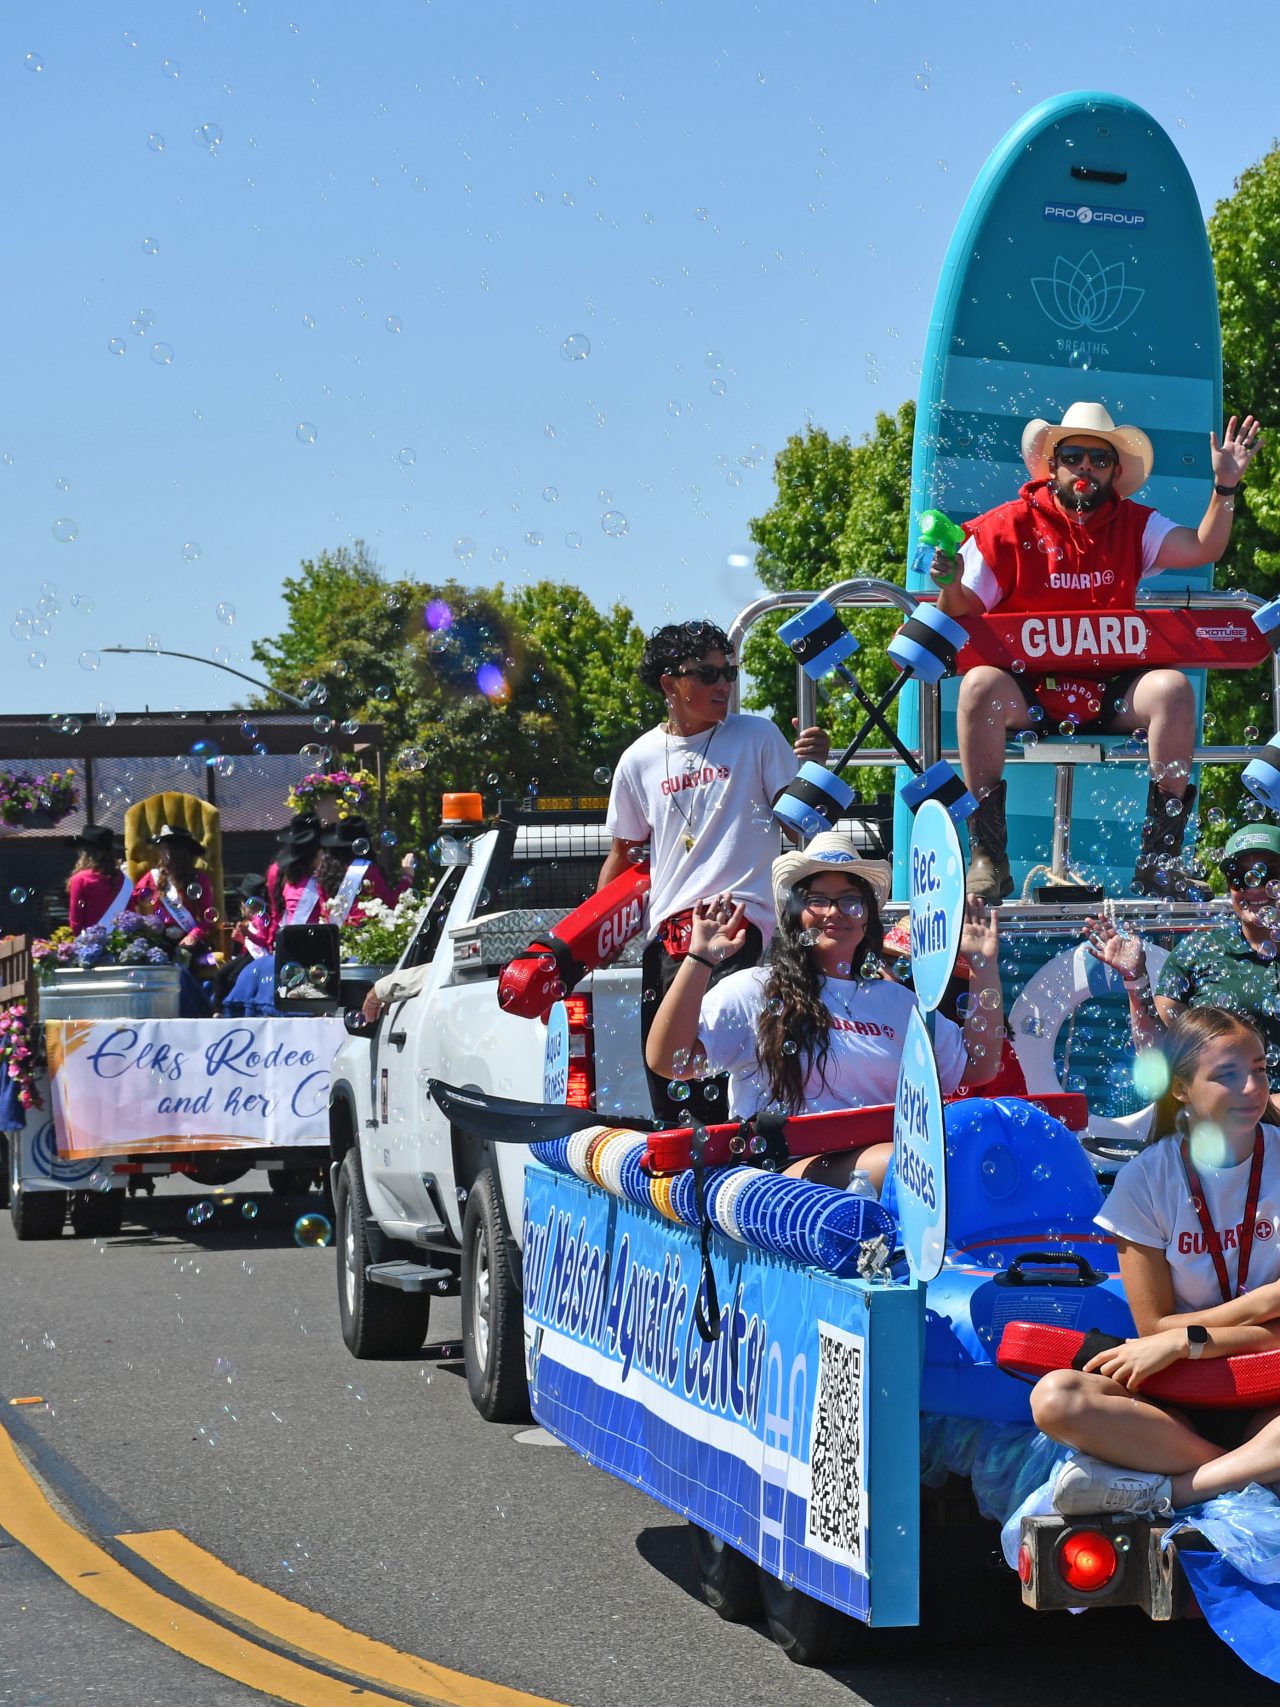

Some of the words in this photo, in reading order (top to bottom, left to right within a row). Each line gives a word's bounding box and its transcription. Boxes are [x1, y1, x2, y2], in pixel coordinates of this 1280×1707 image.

[1044, 206, 1076, 218] PRO
[1093, 212, 1145, 225] GROUP
[1057, 338, 1108, 355] BREATHE
[1050, 571, 1101, 589] GUARD
[1021, 616, 1147, 658] GUARD
[1197, 628, 1246, 637] EXOTUBE
[1055, 682, 1093, 700] GUARD
[661, 767, 715, 796] GUARD
[913, 846, 941, 898] Rec.
[597, 889, 650, 959] GUA
[912, 902, 947, 959] Swim
[831, 1017, 882, 1037] UARD
[87, 1028, 190, 1081] Elks
[205, 1028, 318, 1078] Rodeo
[157, 1086, 215, 1115] and
[224, 1086, 278, 1118] her
[898, 1063, 930, 1143] Kayak
[894, 1122, 936, 1210] Classes
[543, 1209, 612, 1347] Nelson
[602, 1233, 688, 1388] Aquatic
